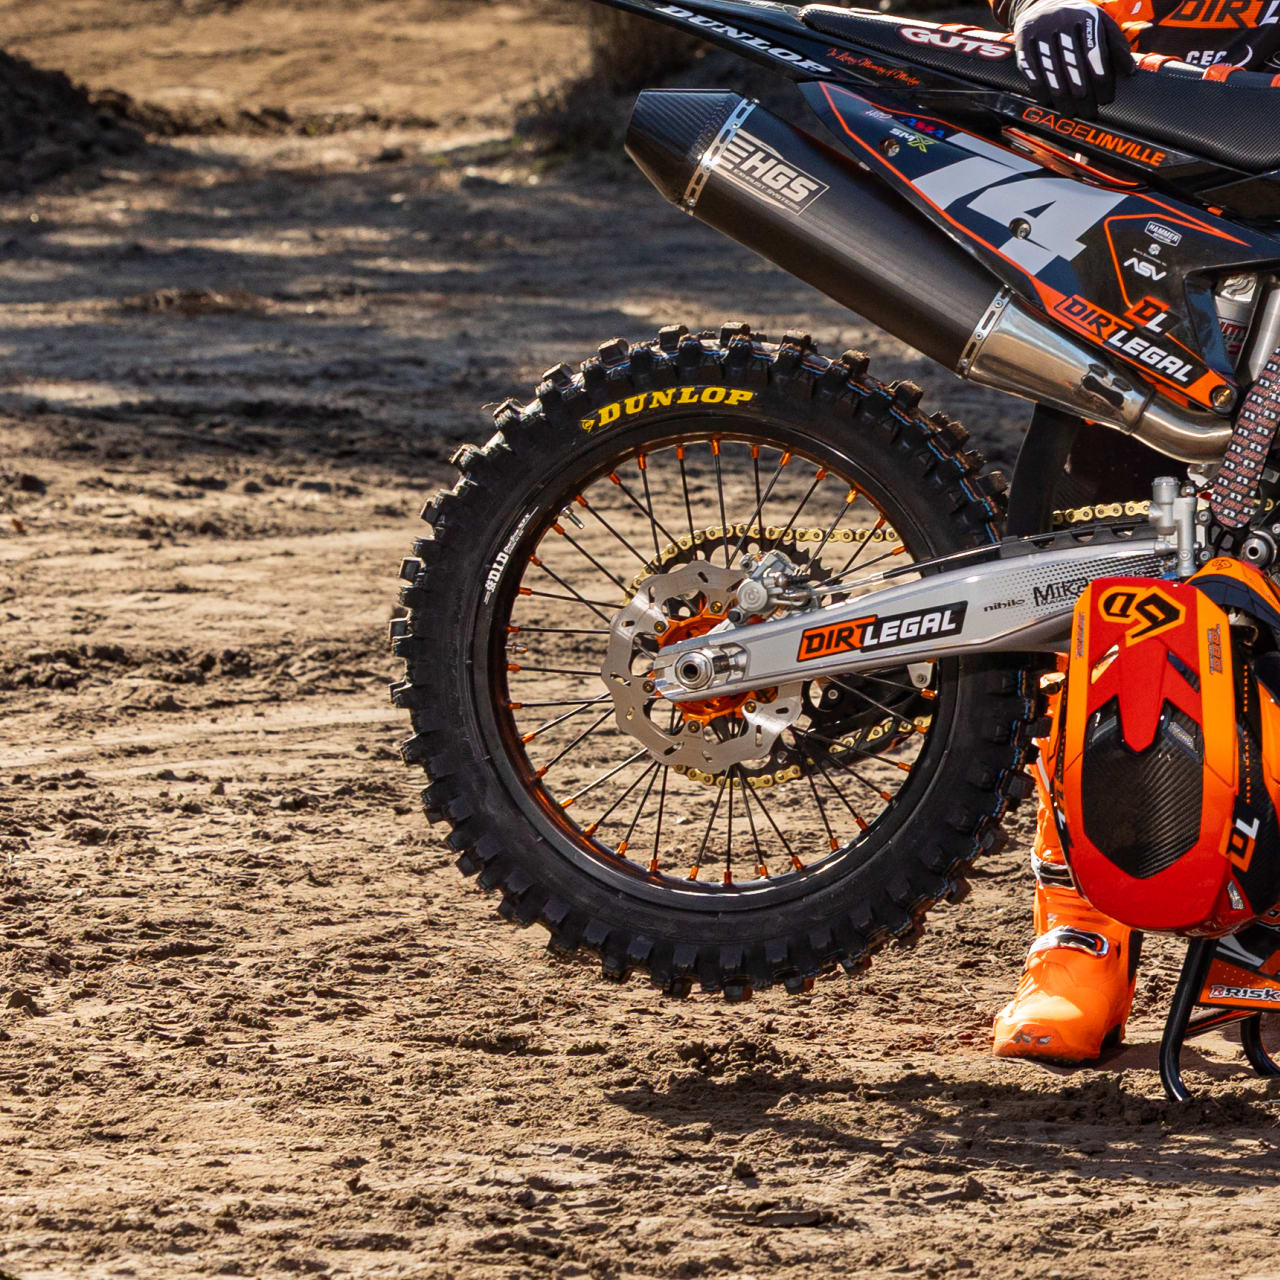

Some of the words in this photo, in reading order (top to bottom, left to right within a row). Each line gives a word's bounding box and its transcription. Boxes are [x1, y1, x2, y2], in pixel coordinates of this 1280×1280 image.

[655, 4, 832, 75] DUNLOP
[900, 27, 1012, 59] GUTS
[739, 150, 820, 203] HGS
[909, 131, 1129, 277] 74
[1123, 256, 1168, 281] ASV
[1060, 298, 1134, 342] DIRT
[1108, 329, 1194, 383] LEGAL
[597, 386, 755, 428] DUNLOP
[983, 598, 1026, 612] nihilo
[804, 621, 870, 657] DIRT
[861, 609, 958, 647] LEGAL
